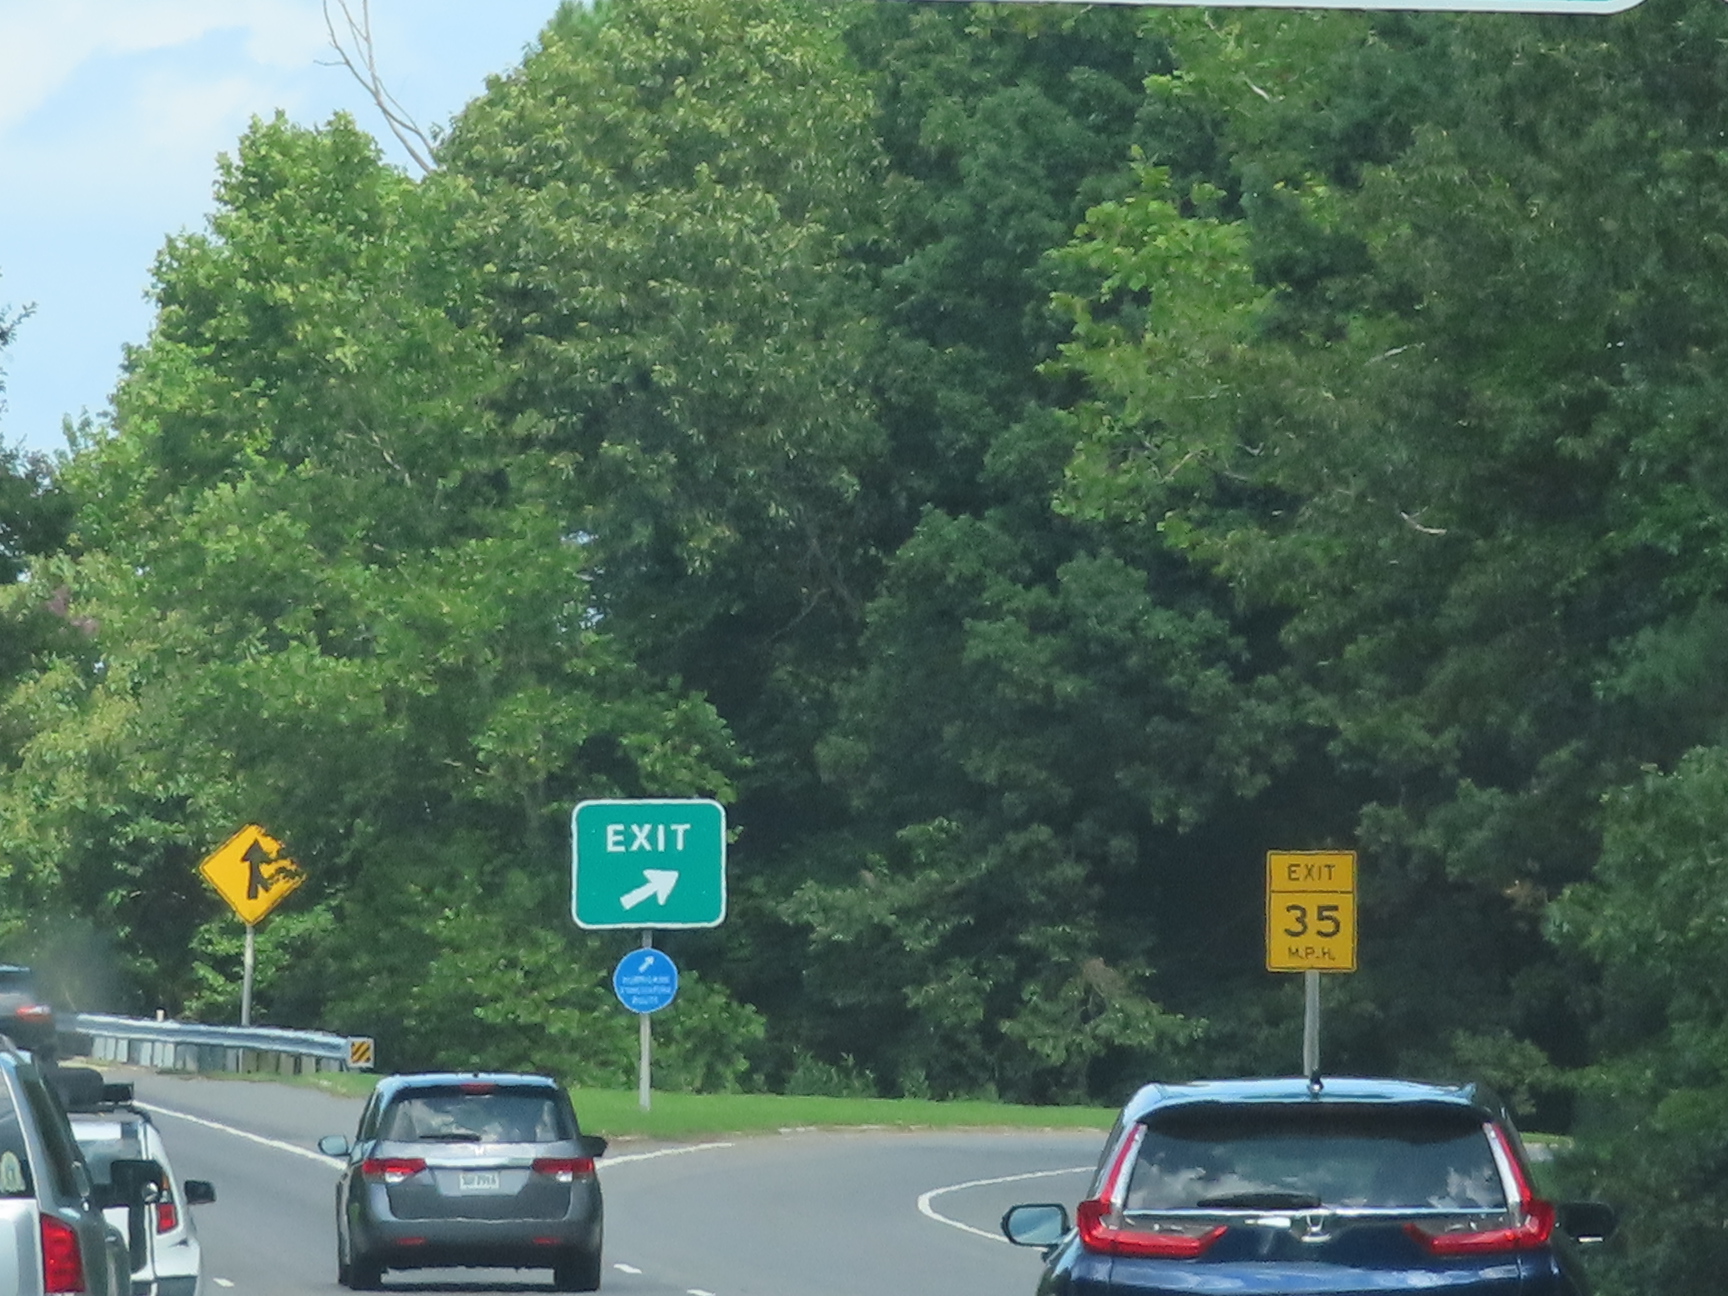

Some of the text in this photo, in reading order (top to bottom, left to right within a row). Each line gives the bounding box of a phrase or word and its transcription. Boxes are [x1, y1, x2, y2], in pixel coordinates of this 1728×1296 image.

[606, 823, 691, 852] EXIT
[1287, 863, 1336, 881] EXIT
[1284, 904, 1341, 937] 35
